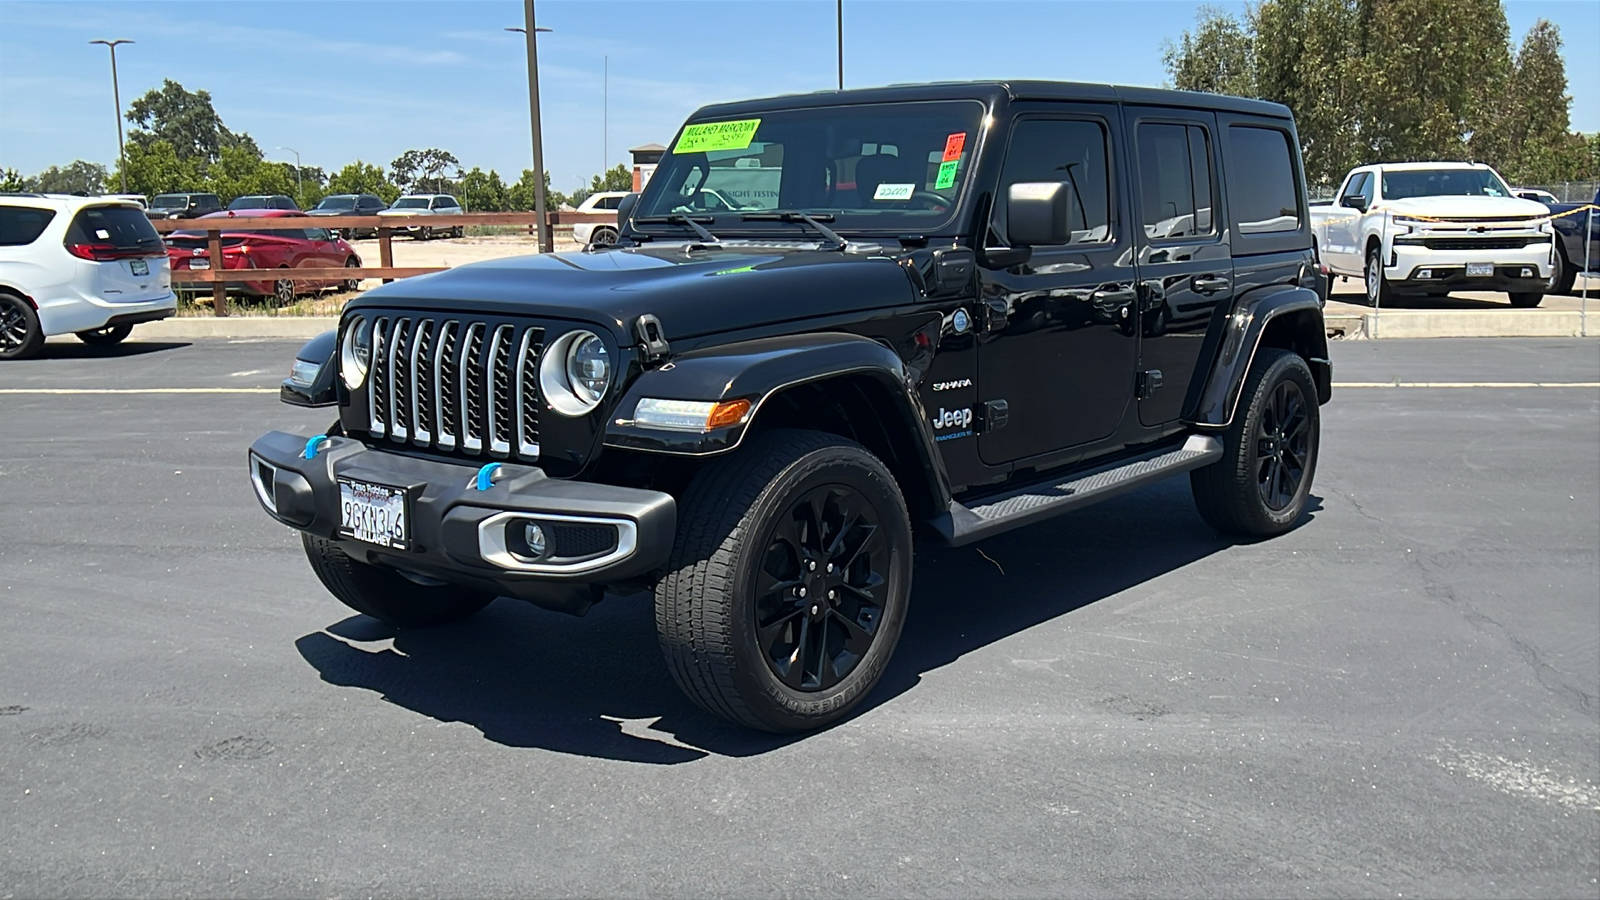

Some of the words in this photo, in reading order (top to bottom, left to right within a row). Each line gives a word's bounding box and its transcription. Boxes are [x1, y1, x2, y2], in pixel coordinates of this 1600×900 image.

[932, 379, 972, 391] SAHARA
[933, 407, 973, 429] Jeep
[345, 501, 403, 538] 9GKN346
